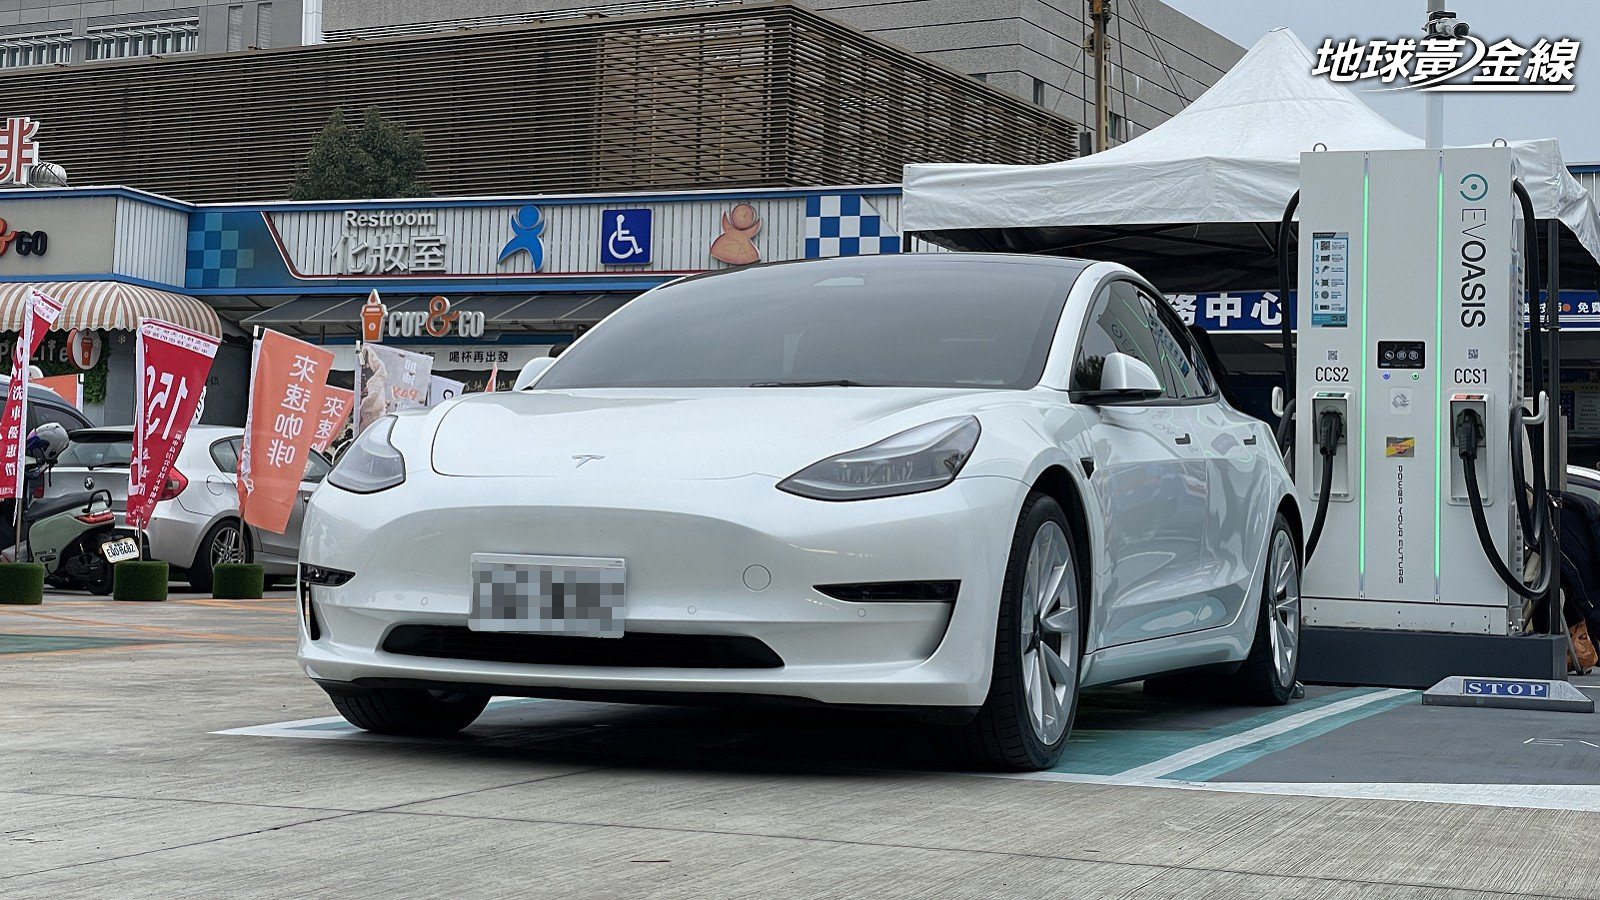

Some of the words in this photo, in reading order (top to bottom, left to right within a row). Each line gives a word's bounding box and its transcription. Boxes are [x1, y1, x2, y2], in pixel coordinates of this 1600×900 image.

[344, 210, 436, 228] Restroom
[332, 233, 447, 274] 化妝室
[1460, 208, 1487, 328] EVOASIS
[449, 350, 509, 363] 喝杯再出發
[1315, 366, 1349, 382] CCS2
[1454, 368, 1487, 384] CCS1
[1468, 682, 1544, 696] STOP
